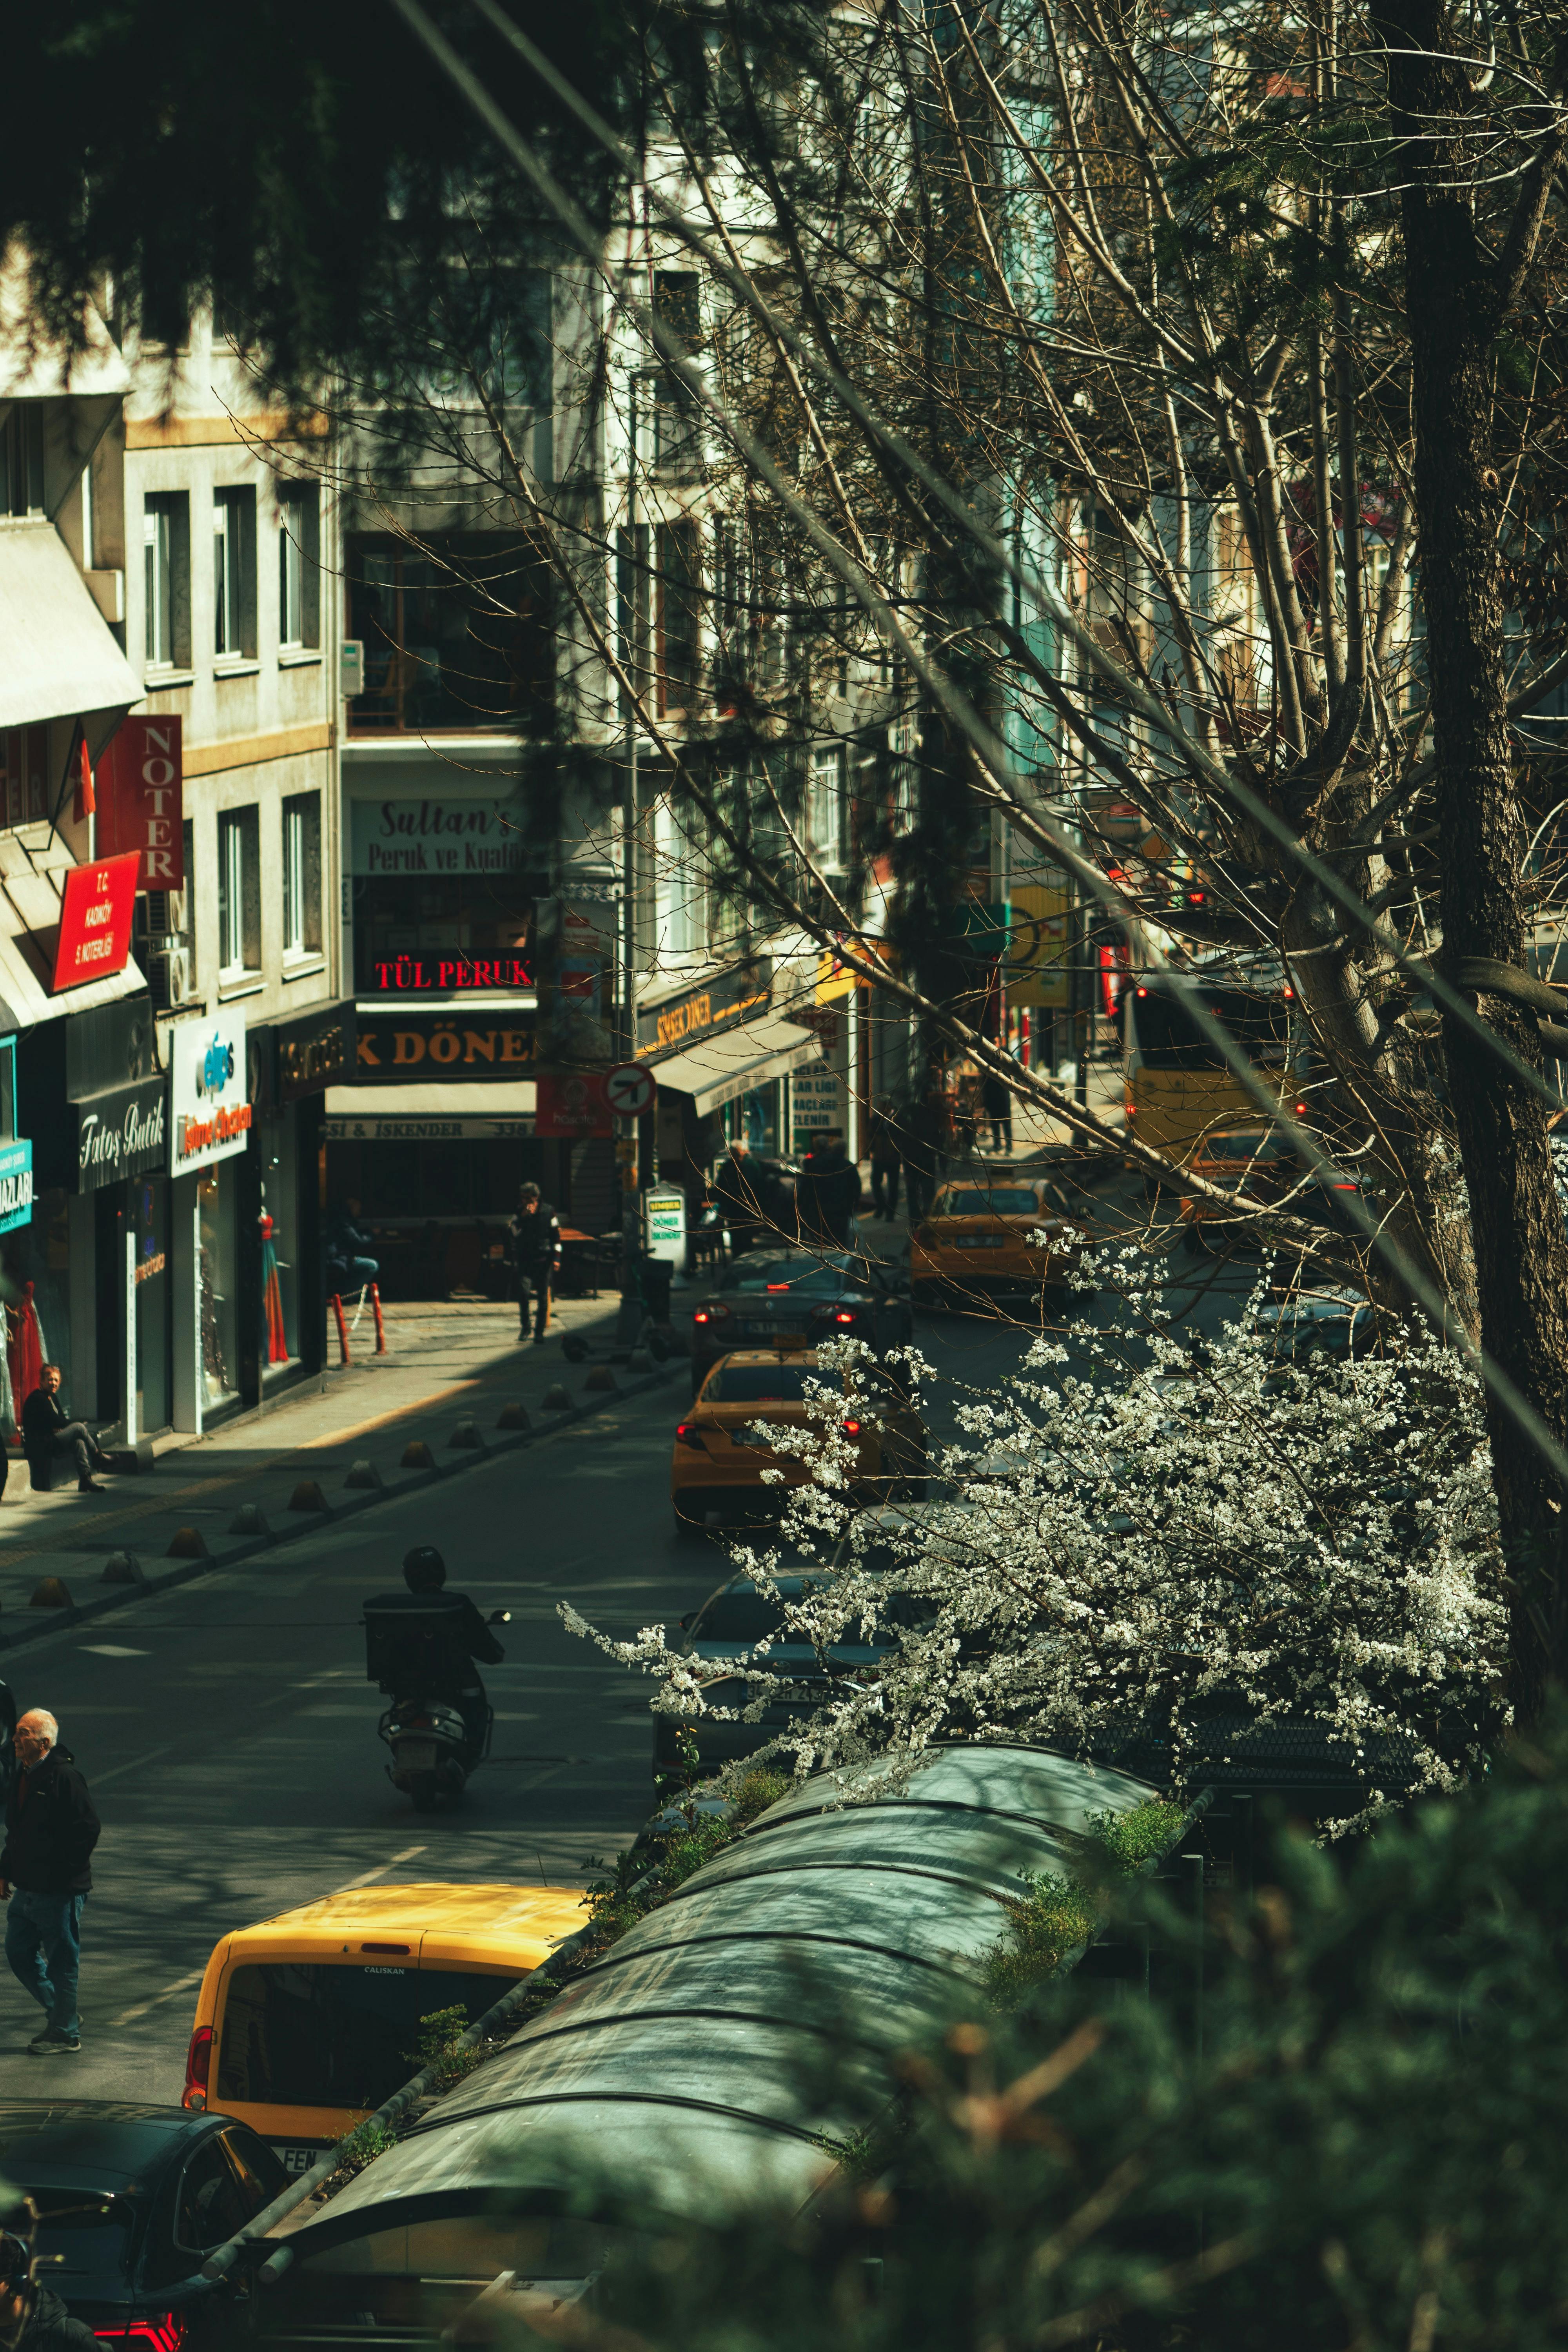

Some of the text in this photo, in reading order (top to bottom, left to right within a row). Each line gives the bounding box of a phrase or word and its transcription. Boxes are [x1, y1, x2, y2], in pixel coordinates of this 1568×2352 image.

[142, 727, 174, 878] NOTER
[379, 801, 511, 837] Sultan's
[369, 843, 428, 871] Peruk
[436, 848, 458, 869] ve
[376, 955, 432, 989] TÜL
[438, 960, 534, 987] PERUK
[392, 1022, 537, 1064] DÖNE
[80, 1095, 164, 1169] Fatoş Butik
[353, 1123, 366, 1137] &
[376, 1120, 463, 1137] İSKENDER
[364, 1966, 405, 1975] CALISKAN
[284, 2149, 317, 2171] FEN
